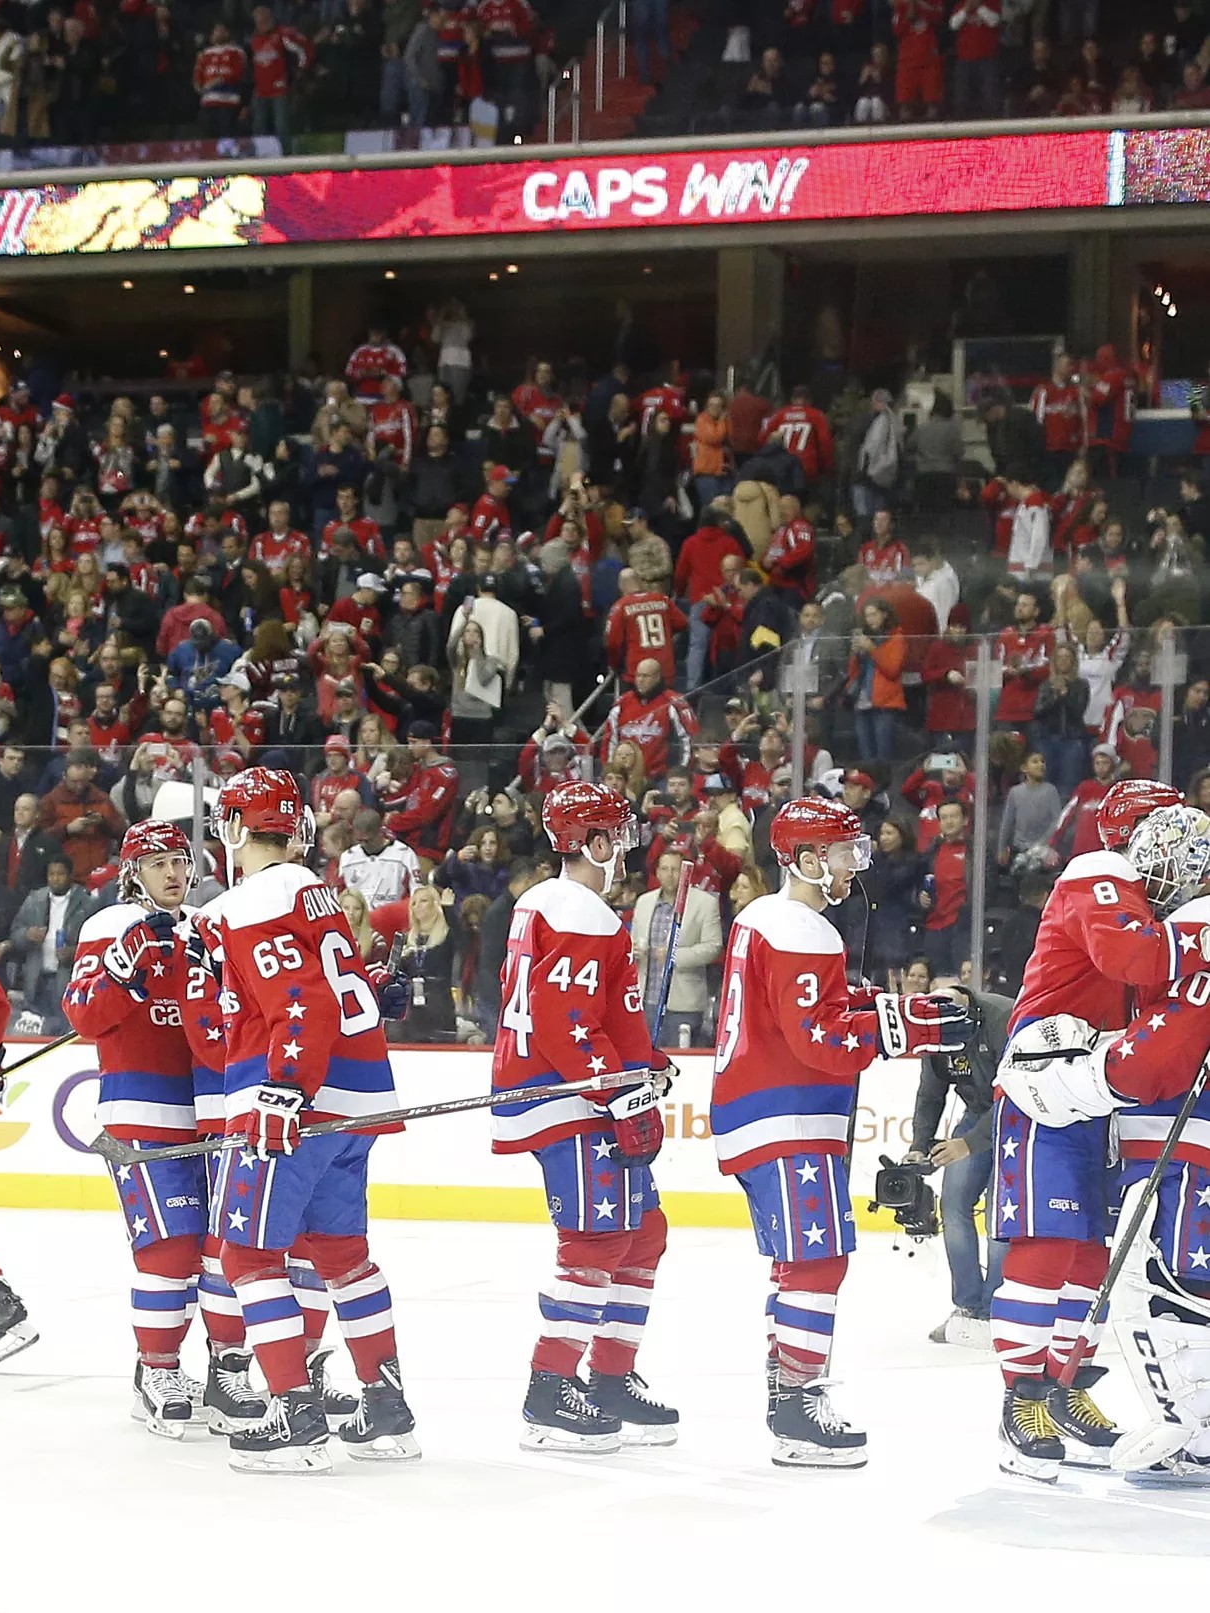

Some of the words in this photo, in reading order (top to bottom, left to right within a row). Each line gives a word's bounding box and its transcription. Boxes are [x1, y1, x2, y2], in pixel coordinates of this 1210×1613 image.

[522, 165, 668, 222] CAPS
[678, 156, 810, 217] WIN!
[636, 613, 666, 648] 19
[279, 800, 295, 815] 65
[1092, 881, 1120, 905] 8
[252, 933, 303, 980] 65
[547, 956, 599, 996] 44
[796, 972, 819, 1008] 3
[1132, 1328, 1183, 1426] CCM
